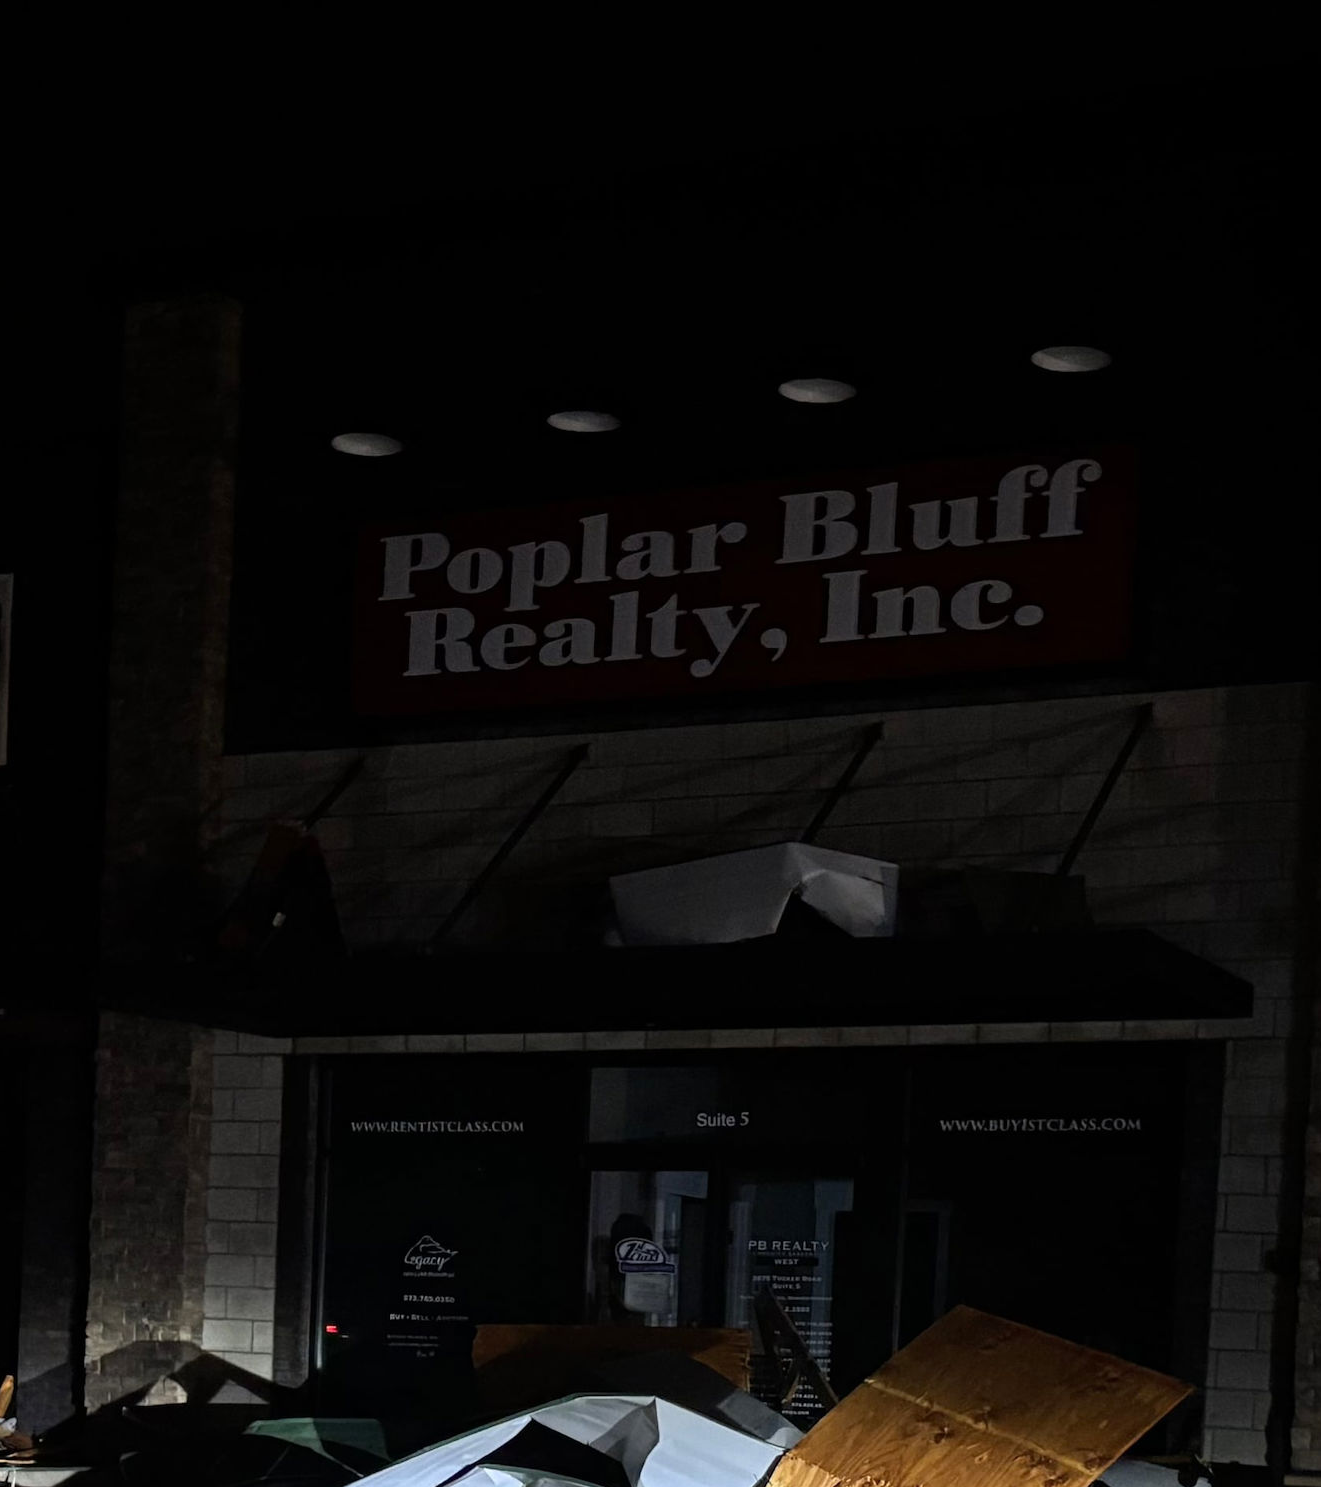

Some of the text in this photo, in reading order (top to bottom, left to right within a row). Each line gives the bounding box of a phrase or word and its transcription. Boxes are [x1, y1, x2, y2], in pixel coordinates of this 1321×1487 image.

[378, 459, 1102, 612] Poplar Bluff
[403, 570, 1044, 678] Realty, Inc.
[696, 1111, 750, 1128] Suite 5
[748, 1240, 830, 1251] PB REALTY
[774, 1258, 799, 1266] WEST
